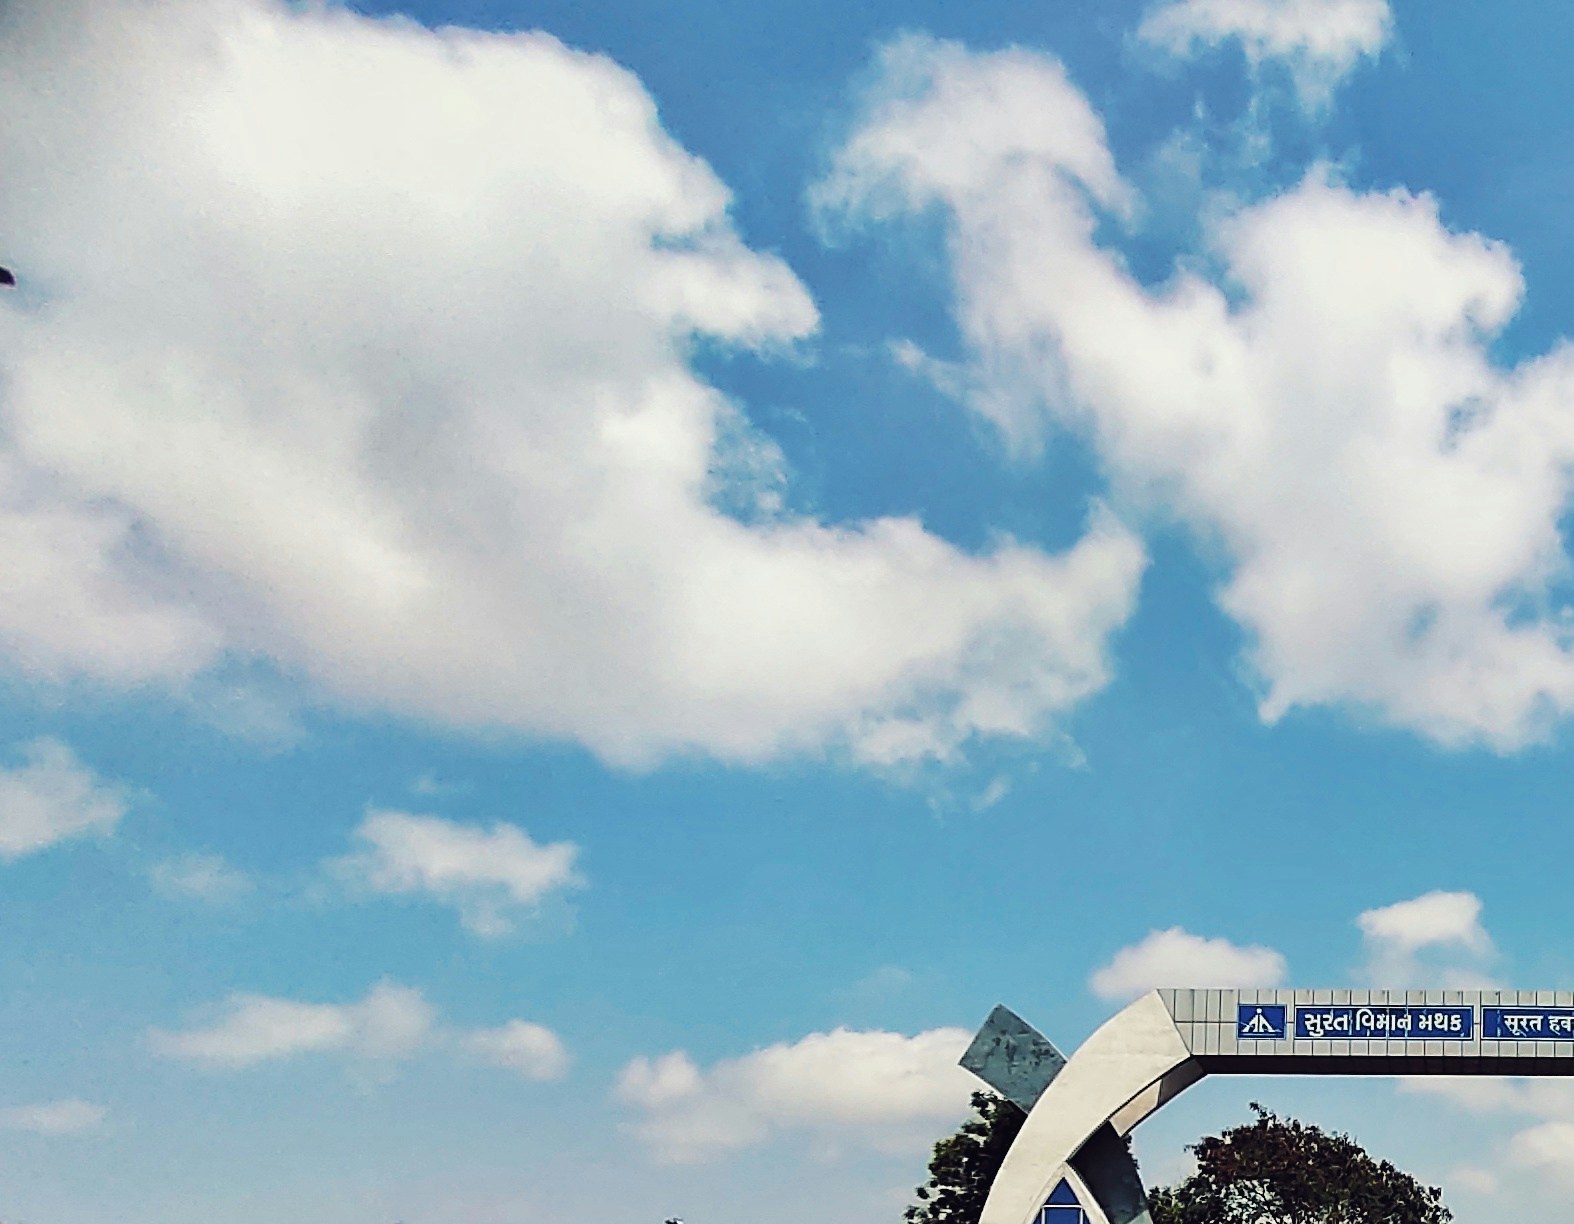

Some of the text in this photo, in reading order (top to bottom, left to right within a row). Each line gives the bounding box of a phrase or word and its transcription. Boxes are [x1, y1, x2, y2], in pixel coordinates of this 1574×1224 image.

[1304, 1008, 1462, 1037] સુરત વિમાન મથક
[1504, 1015, 1544, 1036] सूरत
